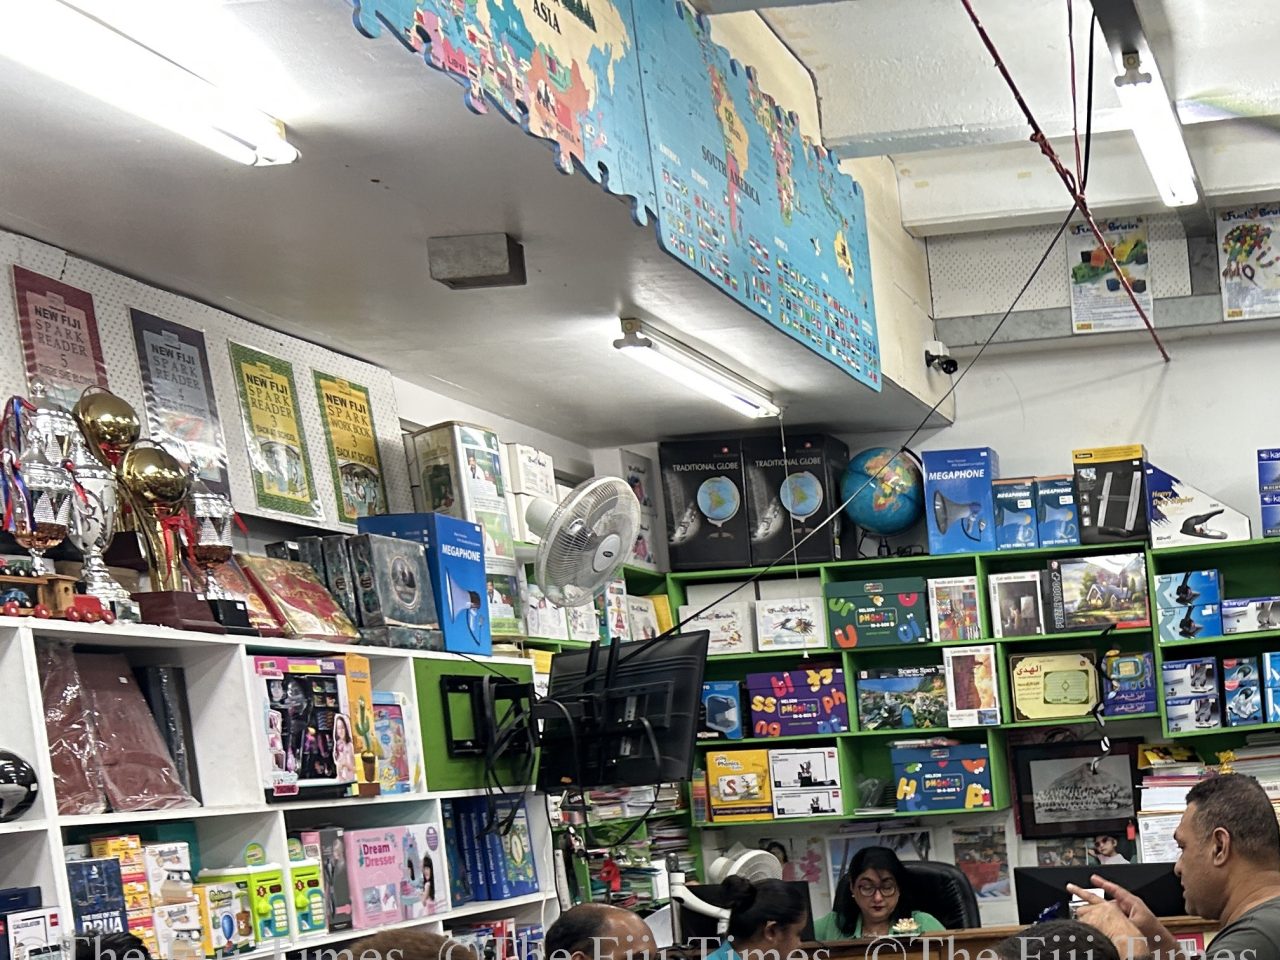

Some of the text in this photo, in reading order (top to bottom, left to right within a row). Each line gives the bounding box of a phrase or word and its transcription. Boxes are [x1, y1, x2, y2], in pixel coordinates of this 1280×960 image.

[533, 0, 562, 35] ASIA
[555, 123, 577, 146] CHINA
[701, 145, 761, 206] SOUTH AMERICA
[34, 306, 81, 328] NEW FIJI
[36, 320, 84, 344] SPARK
[38, 332, 88, 357] READER
[151, 344, 196, 366] NEW FIJI
[60, 354, 69, 368] 5
[152, 355, 198, 379] SPARK
[154, 368, 201, 391] READER
[245, 373, 288, 396] NEW FIJI
[247, 386, 291, 407] SPARK
[325, 392, 366, 415] NEW FIJI
[251, 398, 292, 419] READER
[328, 406, 369, 427] SPARK
[270, 415, 278, 428] 3
[352, 434, 358, 448] 3
[672, 461, 739, 472] TRADITIONAL GLOBE
[755, 457, 821, 467] TRADITIONAL GLOBE
[929, 469, 984, 481] MEGAPHONE
[1039, 487, 1072, 495] MEGAPHONE
[442, 544, 480, 562] MEGAPHONE
[751, 696, 777, 713] ss
[822, 688, 846, 713] ph
[755, 720, 781, 737] ng
[726, 780, 736, 795] S
[896, 777, 917, 800] H
[363, 843, 390, 855] Dream
[365, 855, 396, 868] Dresser
[13, 920, 41, 929] CALCULATOR
[82, 921, 124, 934] DRUA
